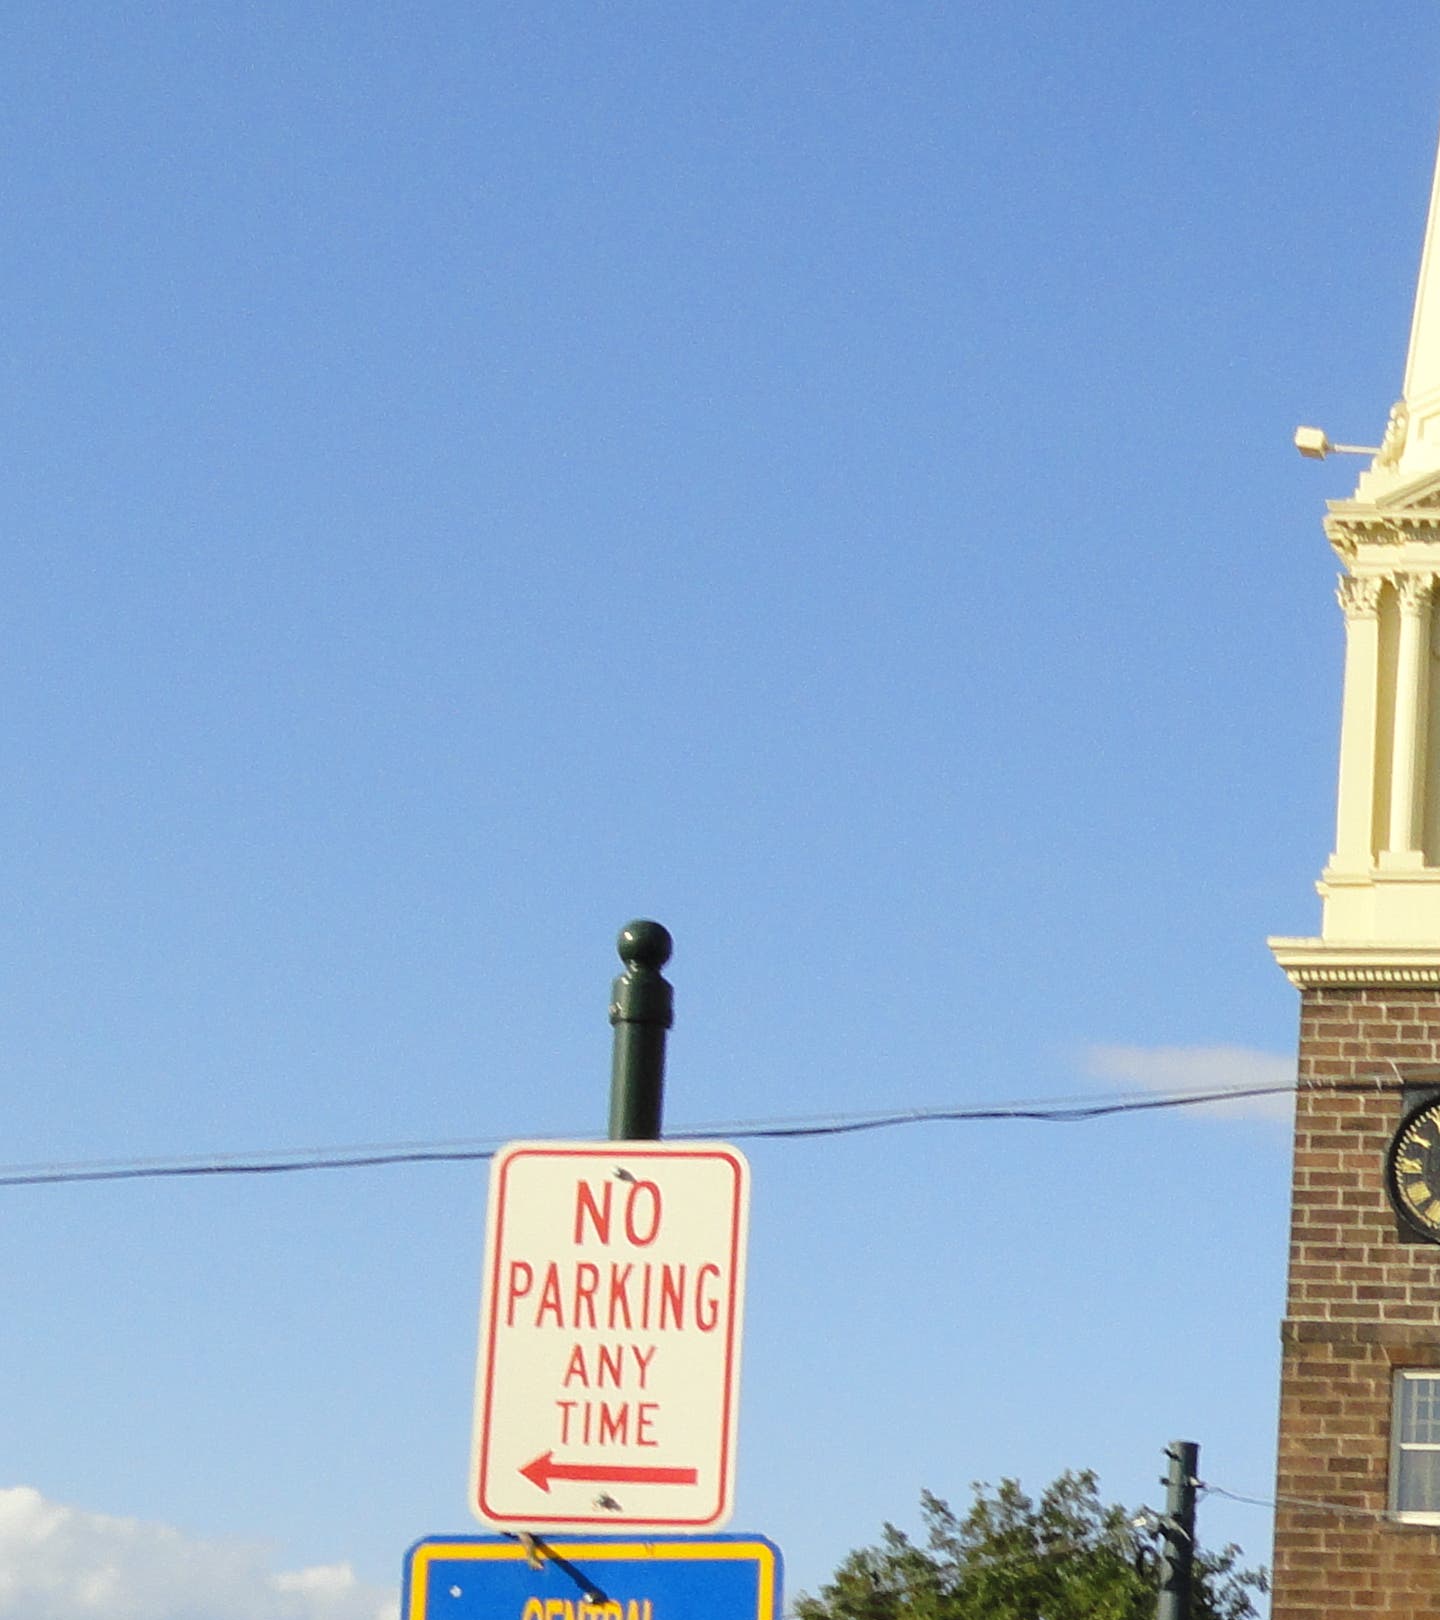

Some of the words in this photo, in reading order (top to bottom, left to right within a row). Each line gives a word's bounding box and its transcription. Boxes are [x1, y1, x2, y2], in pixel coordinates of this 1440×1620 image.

[574, 1180, 662, 1247] NO
[507, 1261, 720, 1332] PARKING
[563, 1345, 656, 1388] ANY
[557, 1401, 659, 1447] TIME
